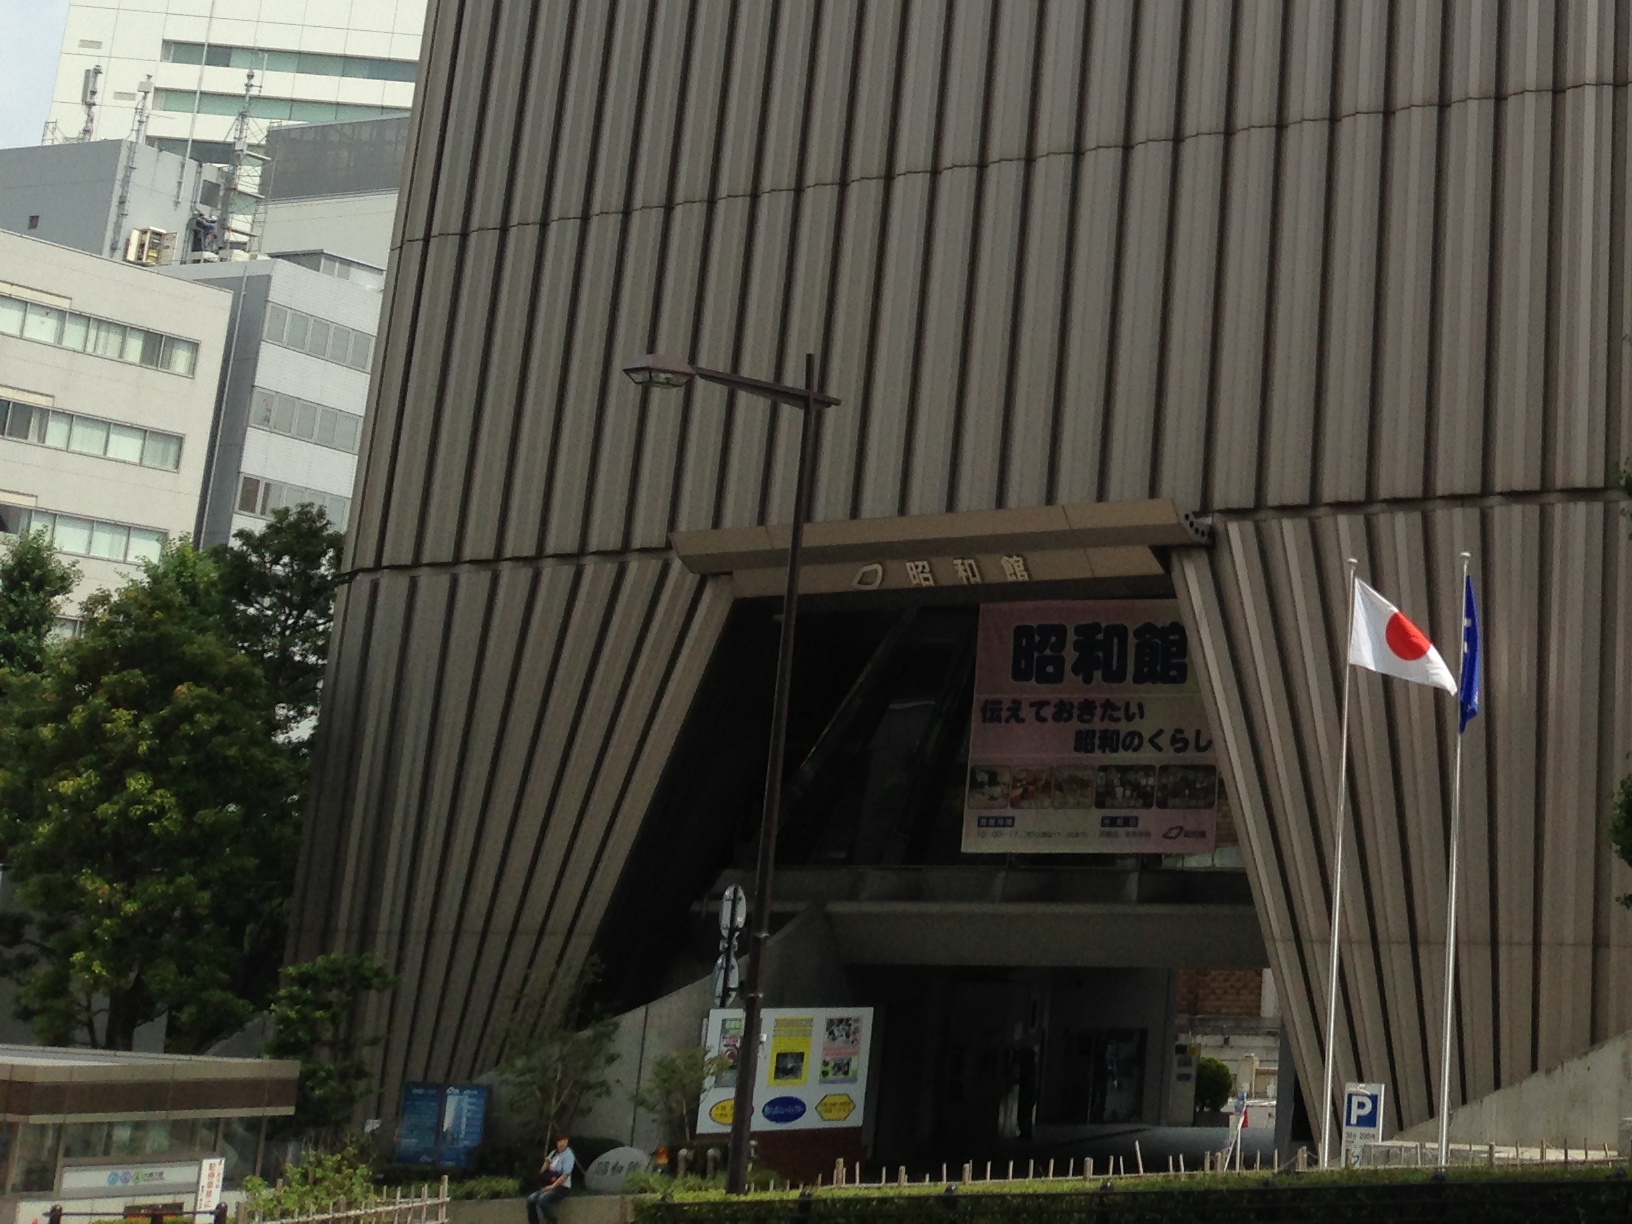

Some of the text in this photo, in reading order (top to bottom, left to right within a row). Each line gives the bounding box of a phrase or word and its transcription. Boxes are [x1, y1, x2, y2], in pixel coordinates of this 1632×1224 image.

[905, 555, 1029, 587] 昭和館
[1011, 621, 1188, 684] 昭和館
[980, 698, 1145, 724] 伝えておきたい
[1073, 728, 1214, 754] 昭和のくらし
[1350, 1095, 1373, 1125] P
